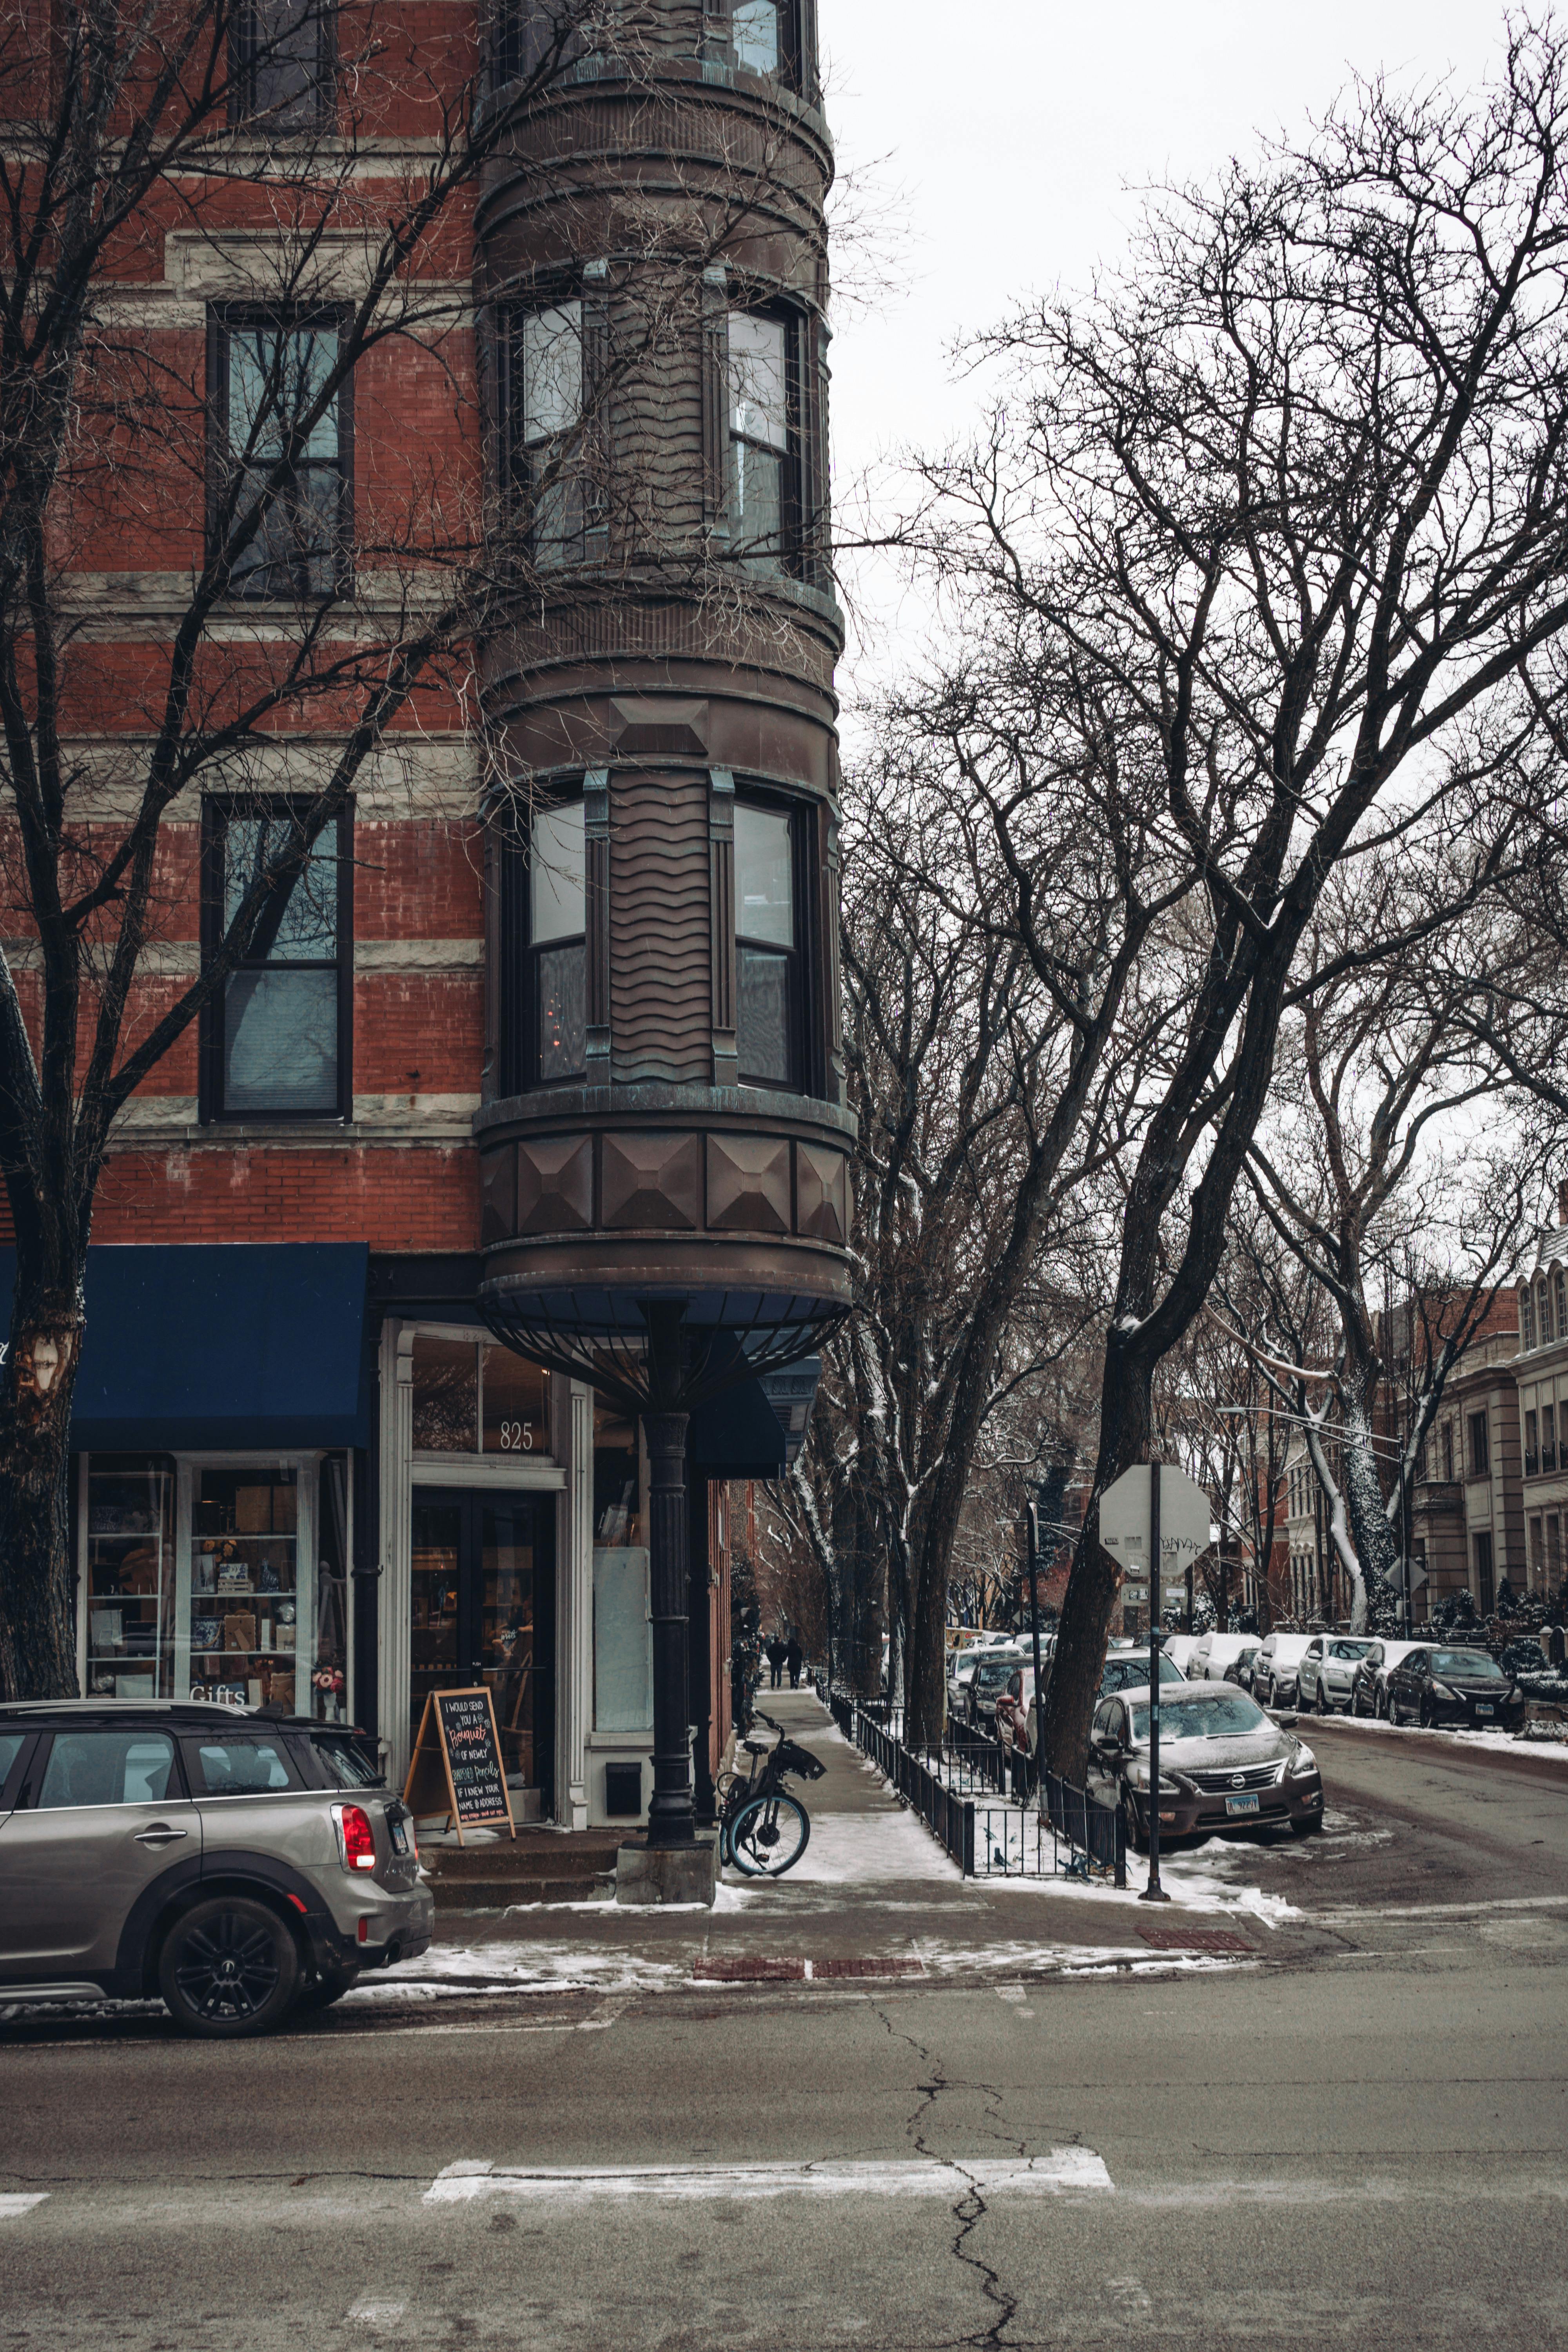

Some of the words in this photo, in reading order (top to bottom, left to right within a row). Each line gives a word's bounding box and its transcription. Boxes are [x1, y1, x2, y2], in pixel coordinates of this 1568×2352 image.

[501, 1421, 532, 1450] 825
[190, 1685, 245, 1705] Gifts
[445, 1703, 448, 1713] I
[449, 1701, 468, 1712] WOULD
[469, 1700, 483, 1711] SEND
[460, 1714, 471, 1727] YOU
[473, 1714, 477, 1724] A
[449, 1724, 486, 1750] Bouquet
[461, 1750, 467, 1760] OF
[469, 1748, 487, 1759] NEWLY
[452, 1767, 474, 1781] SHARPENED
[457, 1788, 463, 1798] IF
[464, 1788, 467, 1797] I
[468, 1786, 483, 1797] KNEW
[485, 1783, 499, 1794] YOUR
[459, 1800, 474, 1811] NAME
[474, 1799, 479, 1809] &
[480, 1797, 503, 1808] ADDRESS
